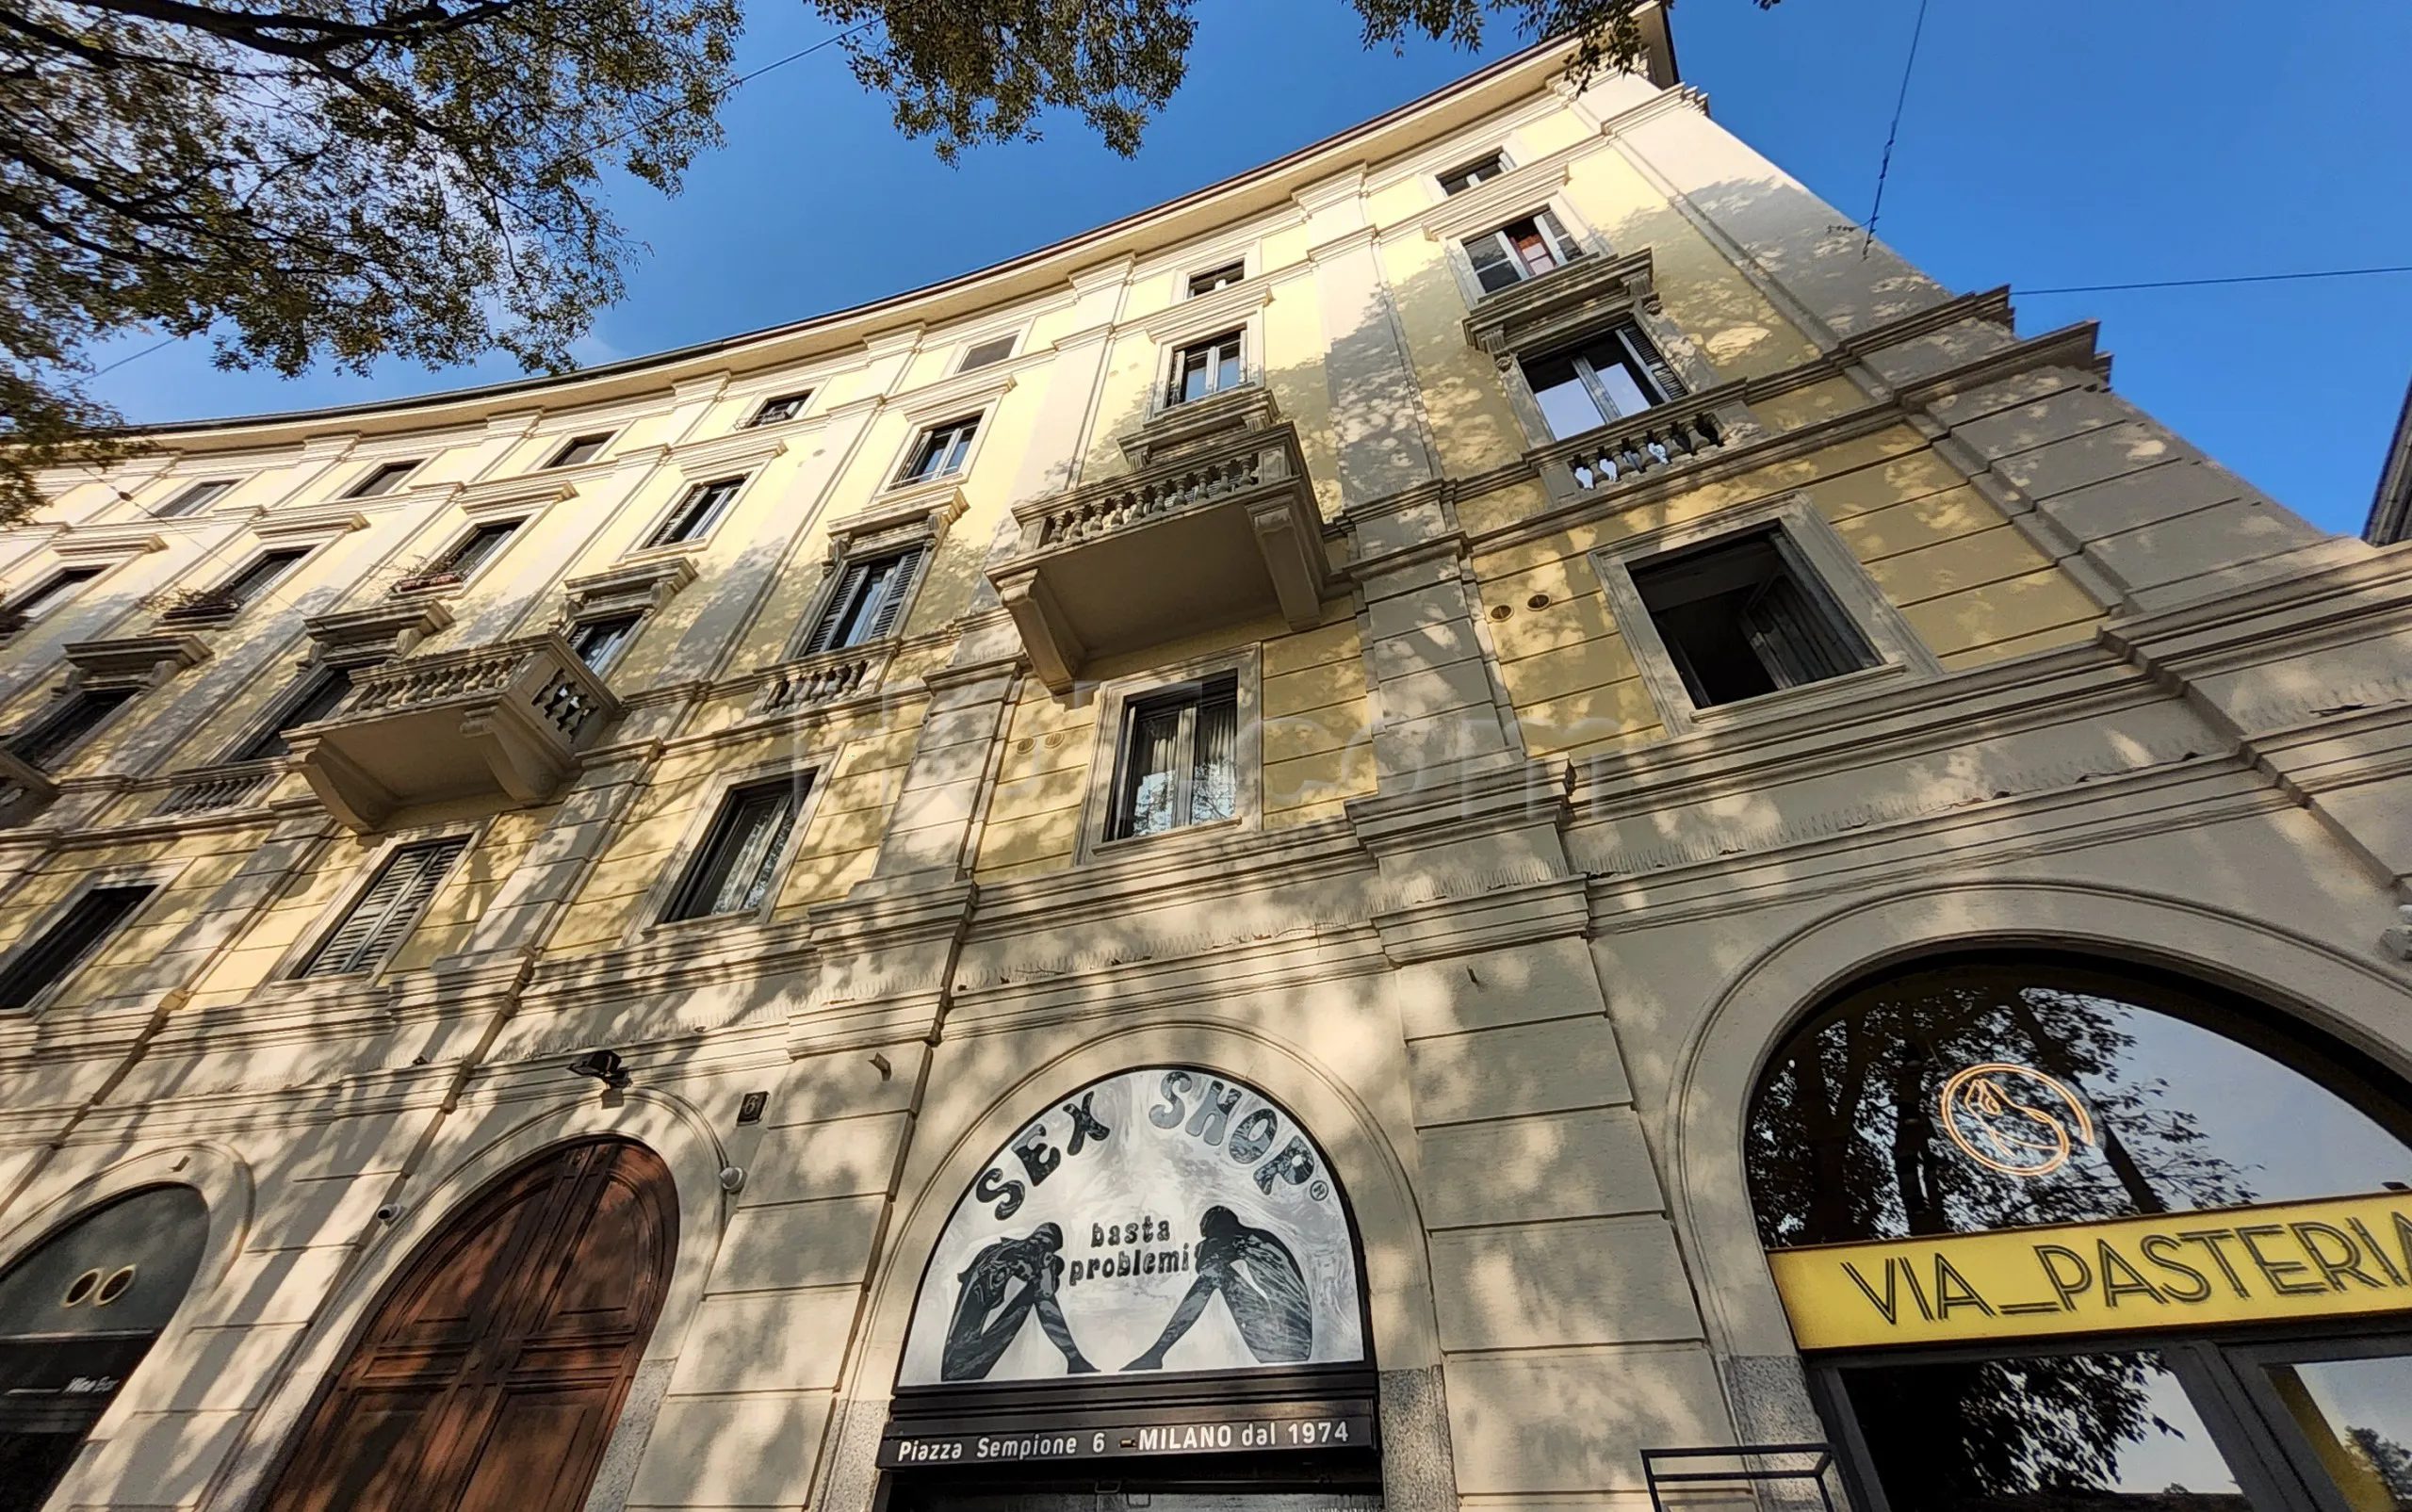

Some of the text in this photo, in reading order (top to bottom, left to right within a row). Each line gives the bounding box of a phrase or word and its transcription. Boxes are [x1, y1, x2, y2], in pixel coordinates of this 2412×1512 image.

[744, 1095, 758, 1114] 6
[975, 1090, 1111, 1221] SEX
[1149, 1070, 1315, 1196] SHOP
[1090, 1215, 1170, 1248] basta
[1068, 1243, 1190, 1287] problemi
[898, 1421, 1348, 1462] Piazza Sempione 6 MILANO dal 1974
